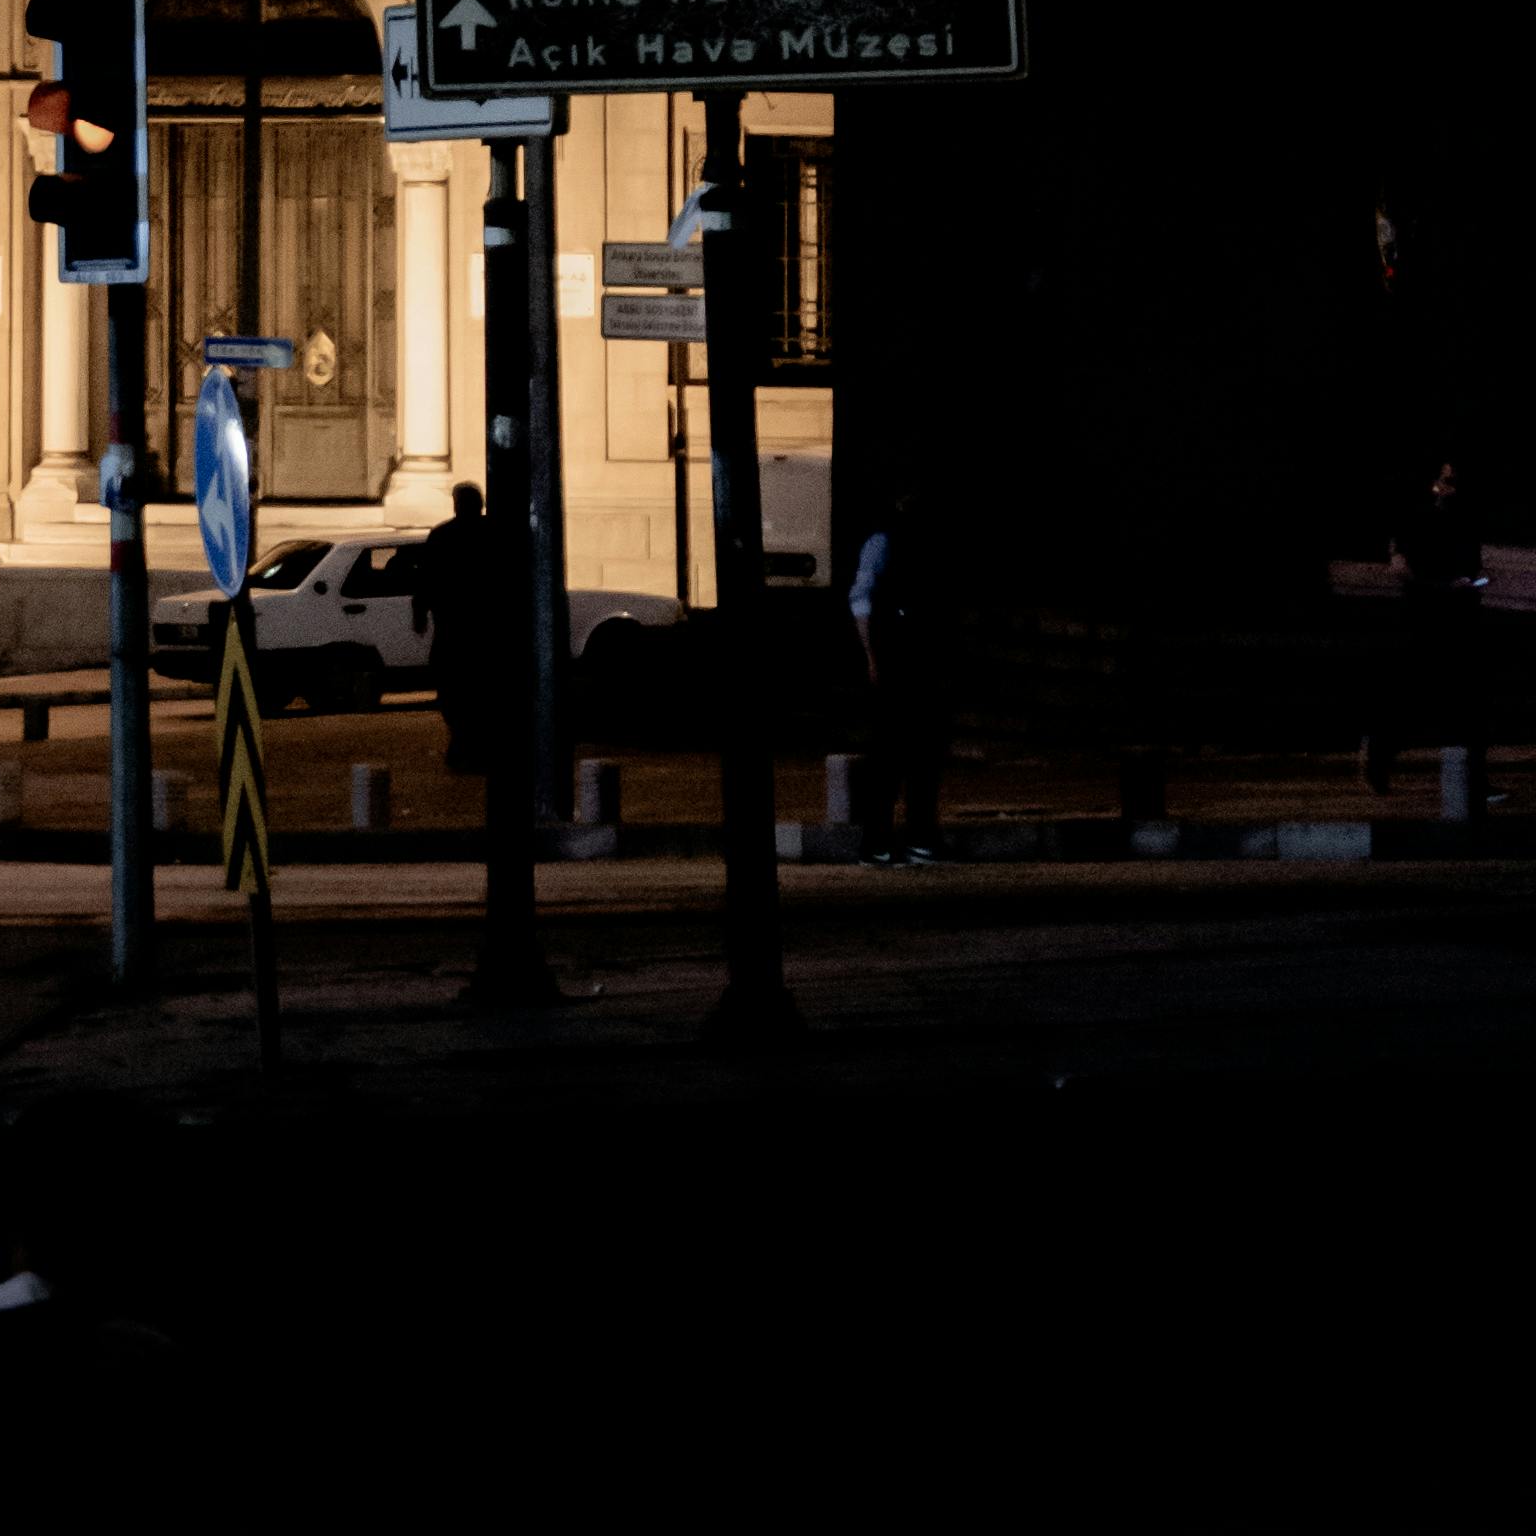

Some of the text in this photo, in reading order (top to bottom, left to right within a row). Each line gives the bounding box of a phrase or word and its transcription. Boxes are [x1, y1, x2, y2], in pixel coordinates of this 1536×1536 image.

[508, 24, 953, 71] Açık Hava Müzesi
